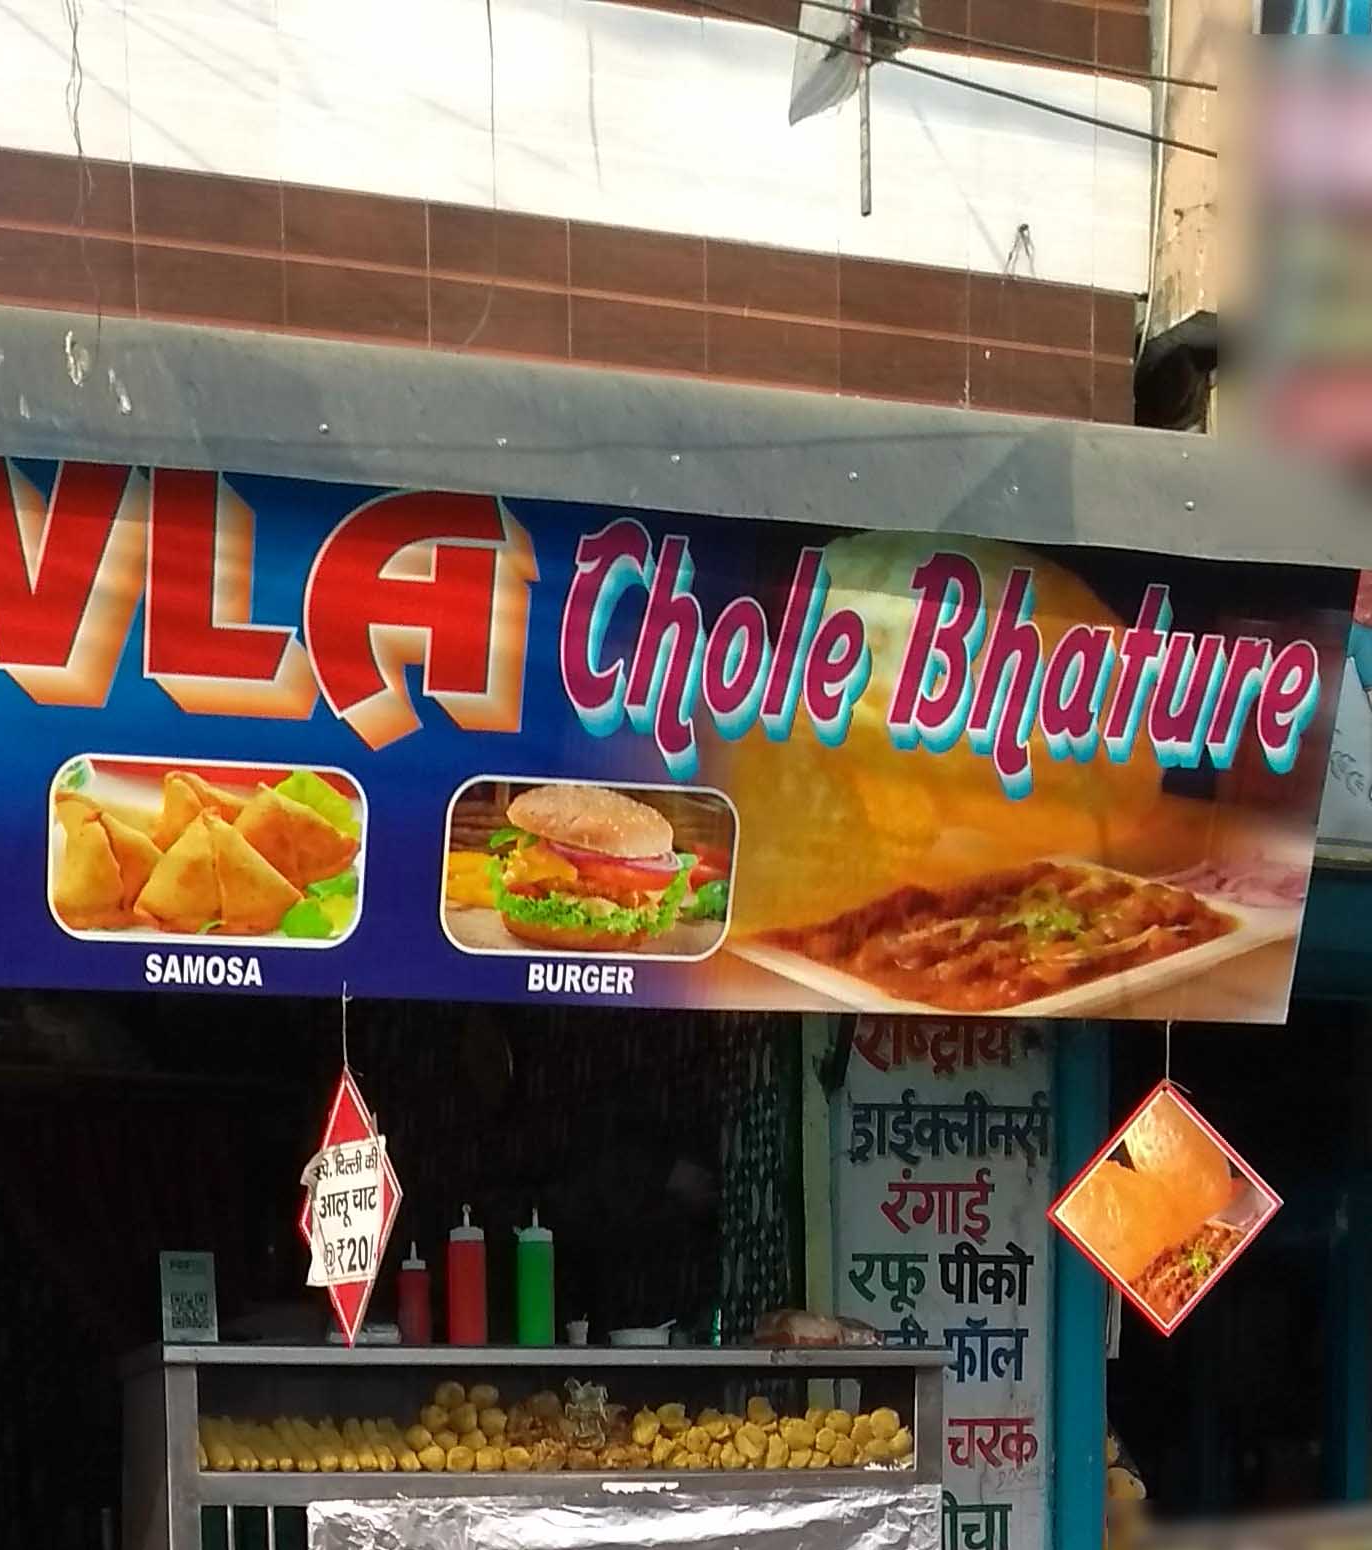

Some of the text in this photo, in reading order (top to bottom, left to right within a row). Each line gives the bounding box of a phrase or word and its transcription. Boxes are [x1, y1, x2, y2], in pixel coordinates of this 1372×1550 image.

[560, 518, 1322, 799] Chole Bhature
[145, 954, 262, 986] SAMOSA
[528, 962, 633, 995] BURGER
[319, 1185, 378, 1227] आलू चाट
[881, 1168, 995, 1244] रंगाई
[848, 1241, 1034, 1313] रफू पीको
